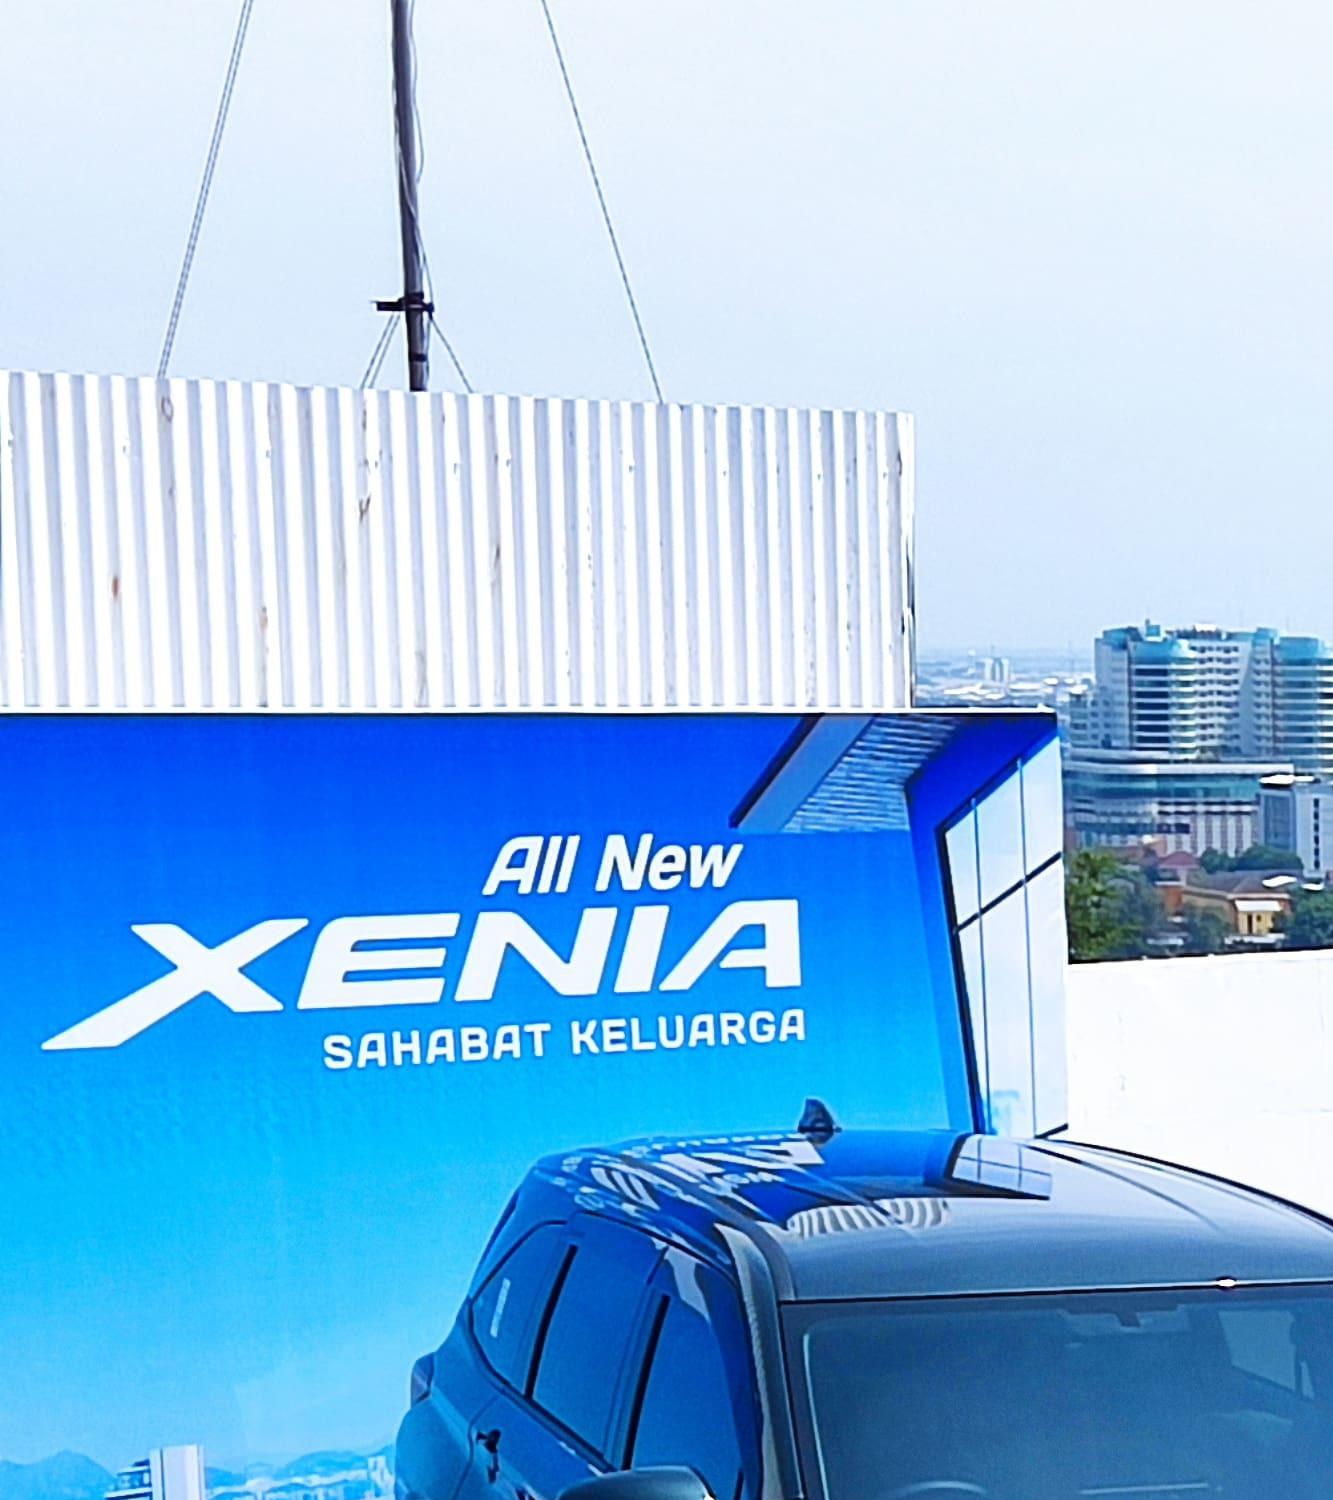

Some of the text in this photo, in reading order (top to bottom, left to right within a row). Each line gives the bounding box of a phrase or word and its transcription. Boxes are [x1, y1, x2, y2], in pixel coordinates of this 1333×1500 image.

[482, 833, 743, 895] All New
[41, 898, 801, 1051] XENIA
[323, 1008, 806, 1069] SAHABAT KELUARGA
